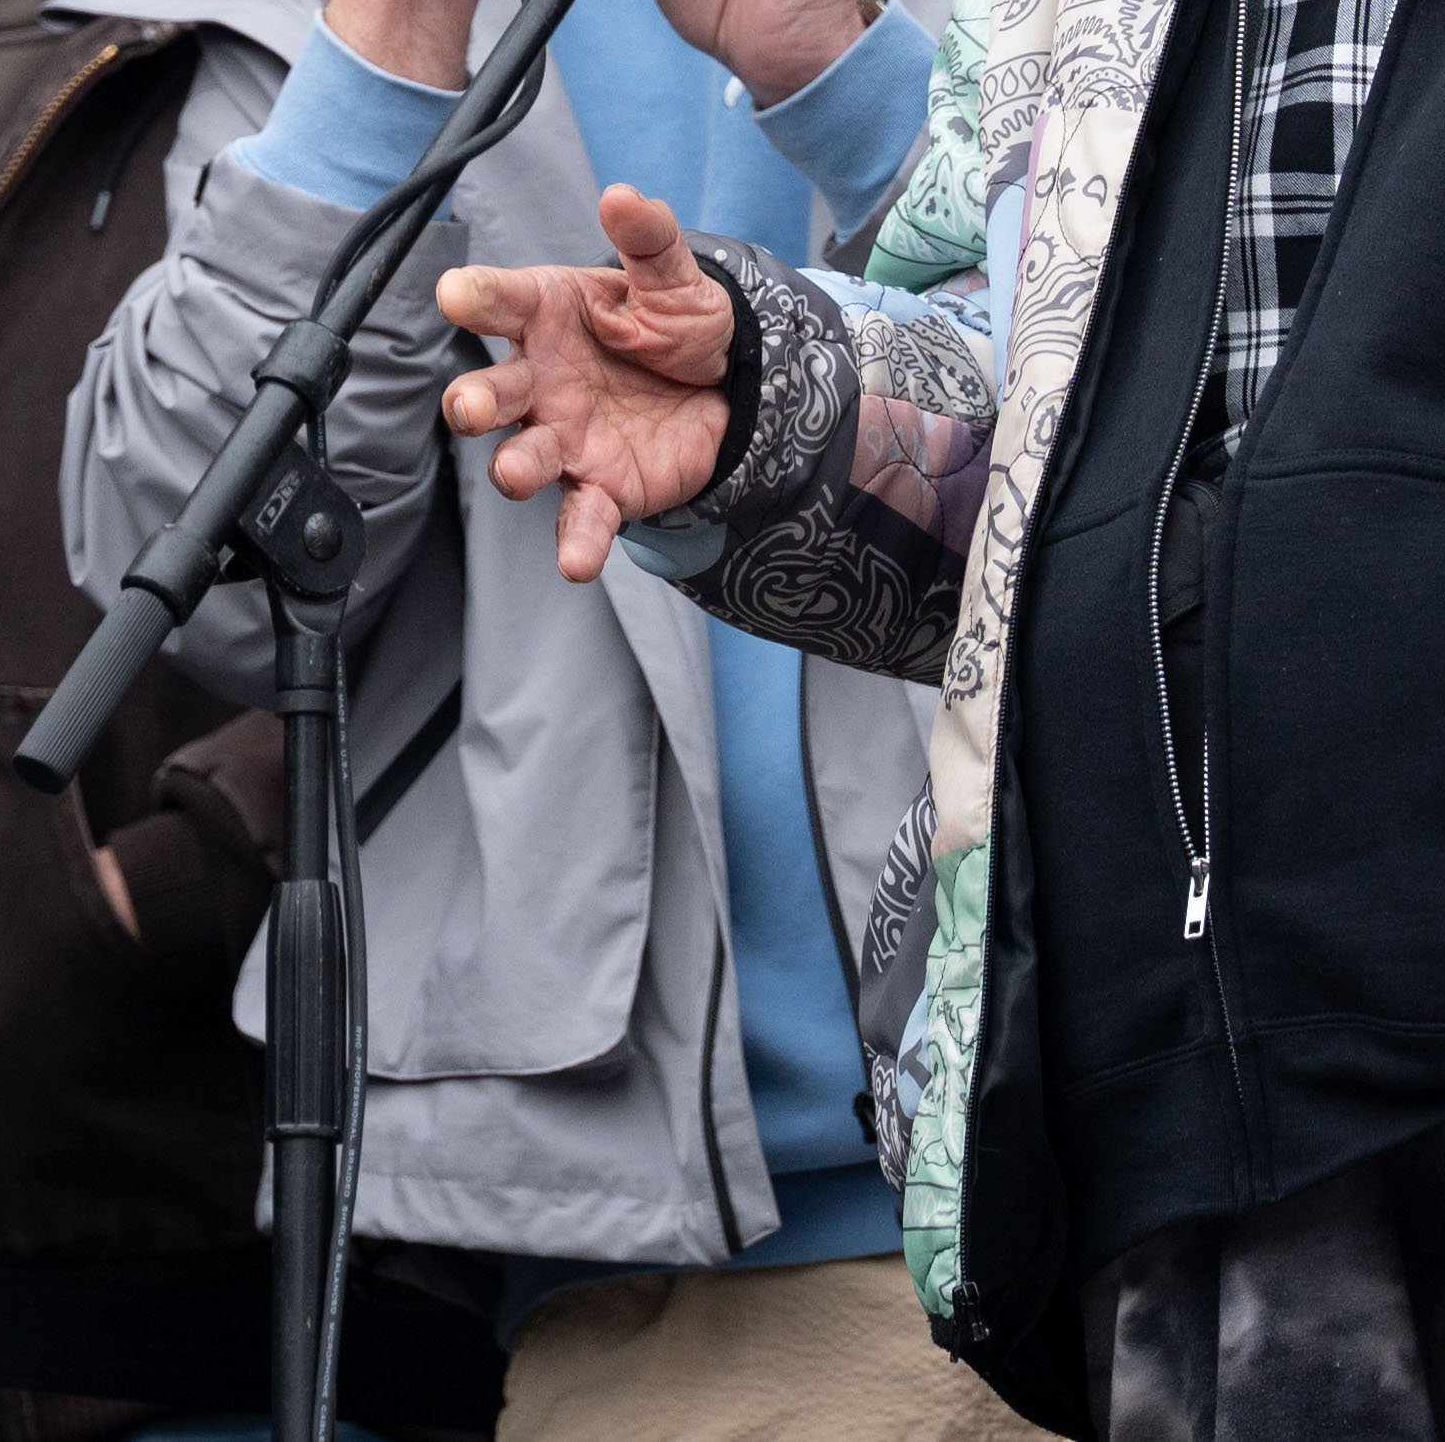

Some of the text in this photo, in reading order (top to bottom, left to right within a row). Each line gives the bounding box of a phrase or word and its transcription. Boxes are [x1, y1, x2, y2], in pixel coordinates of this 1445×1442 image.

[350, 1056, 361, 1141] PROFESSIONAL
[343, 1148, 354, 1198] BRAIDED
[336, 1205, 348, 1246] SHIELD
[329, 1252, 342, 1315] BALANCED
[321, 1322, 335, 1399] MICROPHONE
